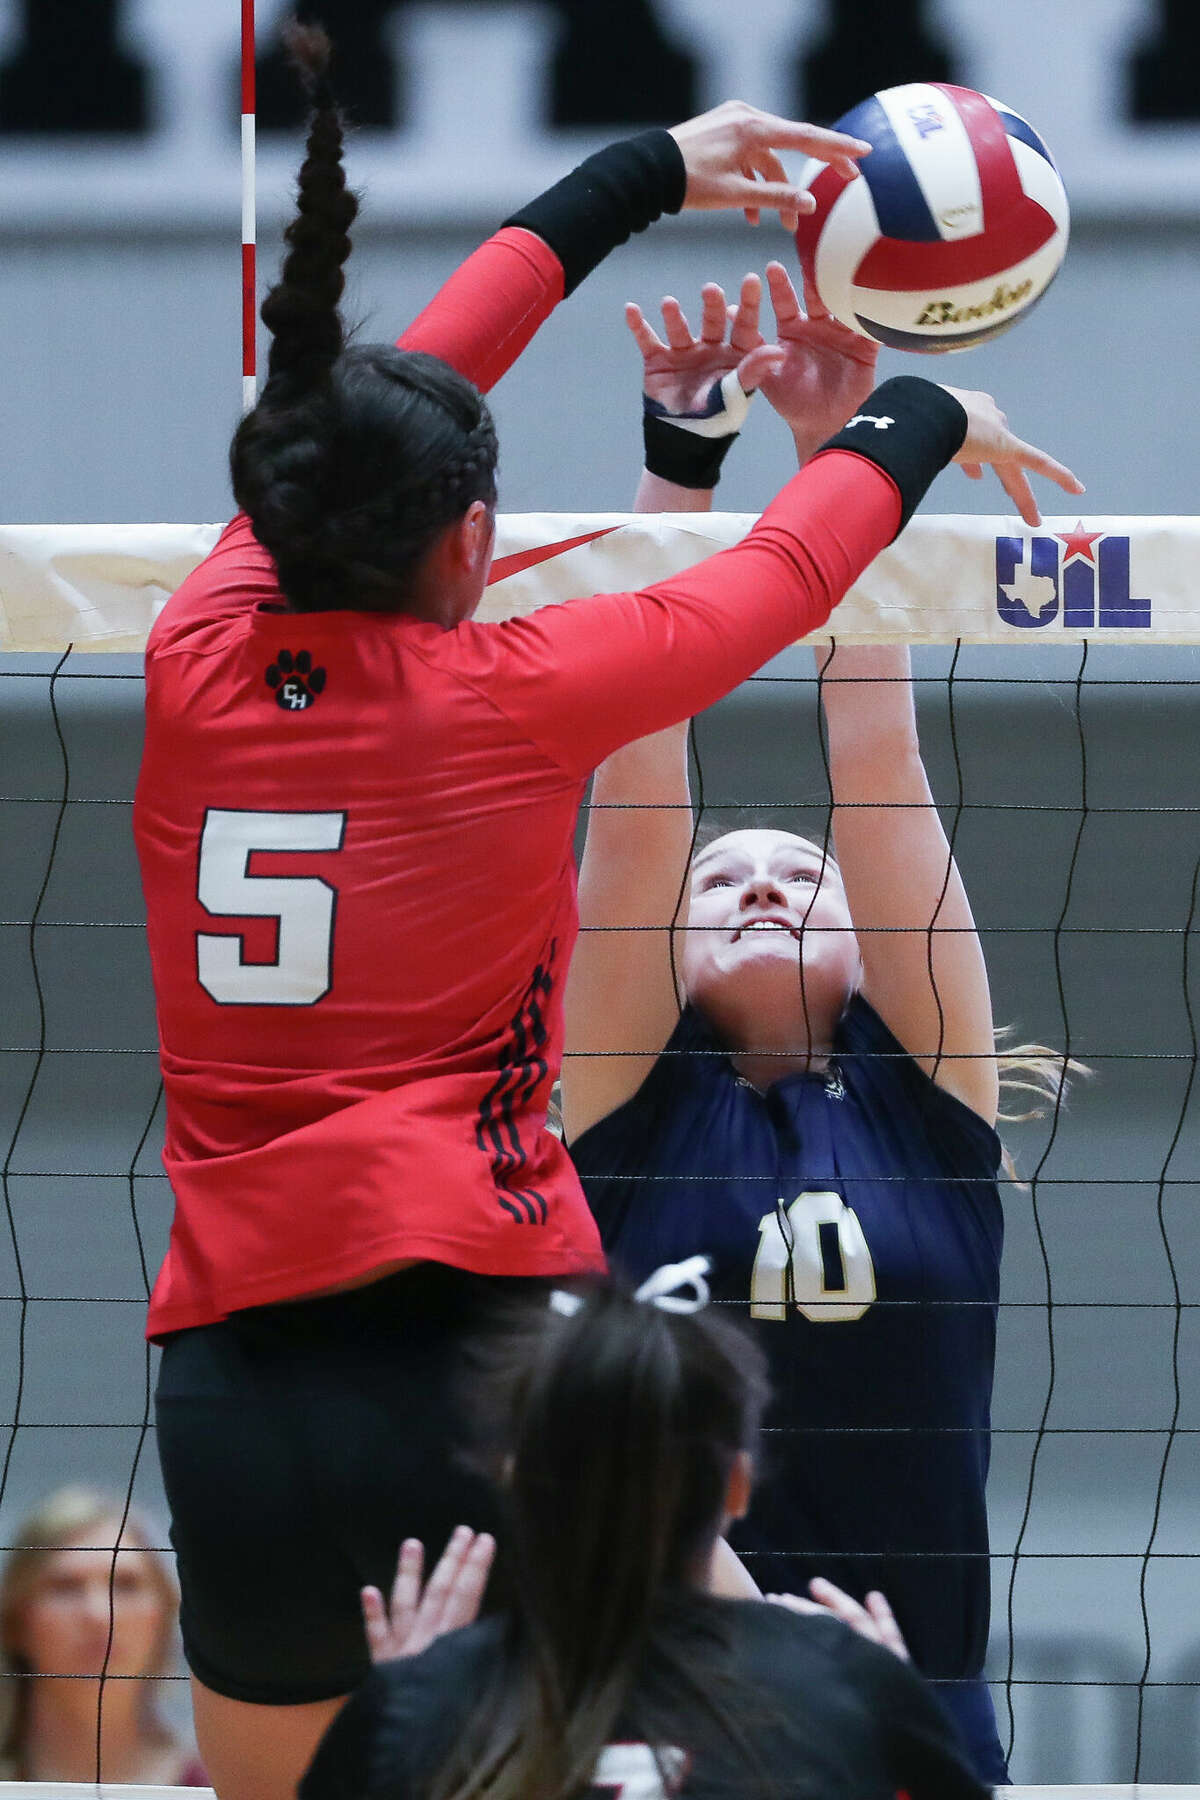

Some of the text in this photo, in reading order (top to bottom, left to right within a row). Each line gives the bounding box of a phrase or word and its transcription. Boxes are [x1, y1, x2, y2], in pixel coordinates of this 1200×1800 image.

[996, 528, 1151, 628] UIL
[283, 684, 307, 709] CH
[195, 806, 348, 1006] 5
[750, 1191, 877, 1322] 10
